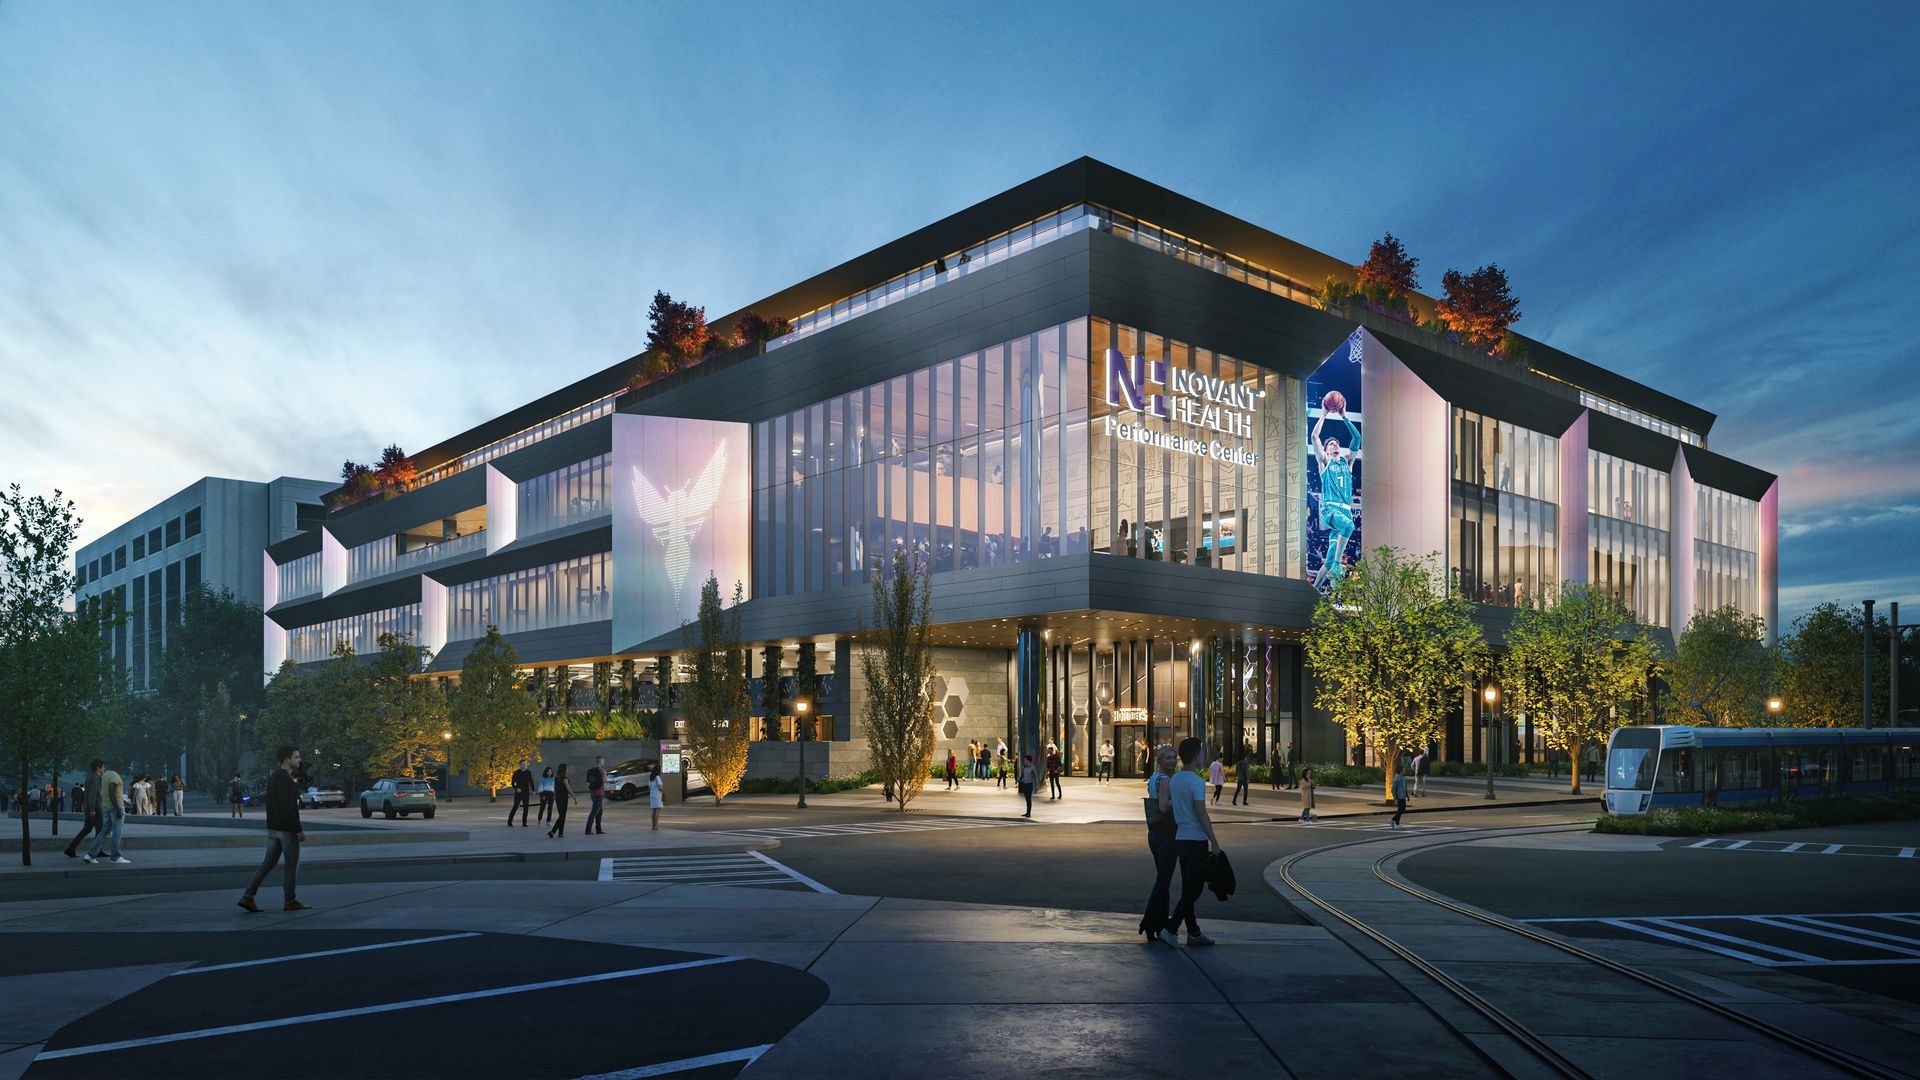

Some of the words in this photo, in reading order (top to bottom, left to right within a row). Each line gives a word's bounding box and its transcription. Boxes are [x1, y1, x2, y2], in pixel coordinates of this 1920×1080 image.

[1172, 366, 1259, 412] NOVANT
[1171, 395, 1252, 439] HEALTH
[1105, 414, 1208, 456] Performance
[1209, 439, 1259, 468] Center
[1337, 476, 1344, 488] 1
